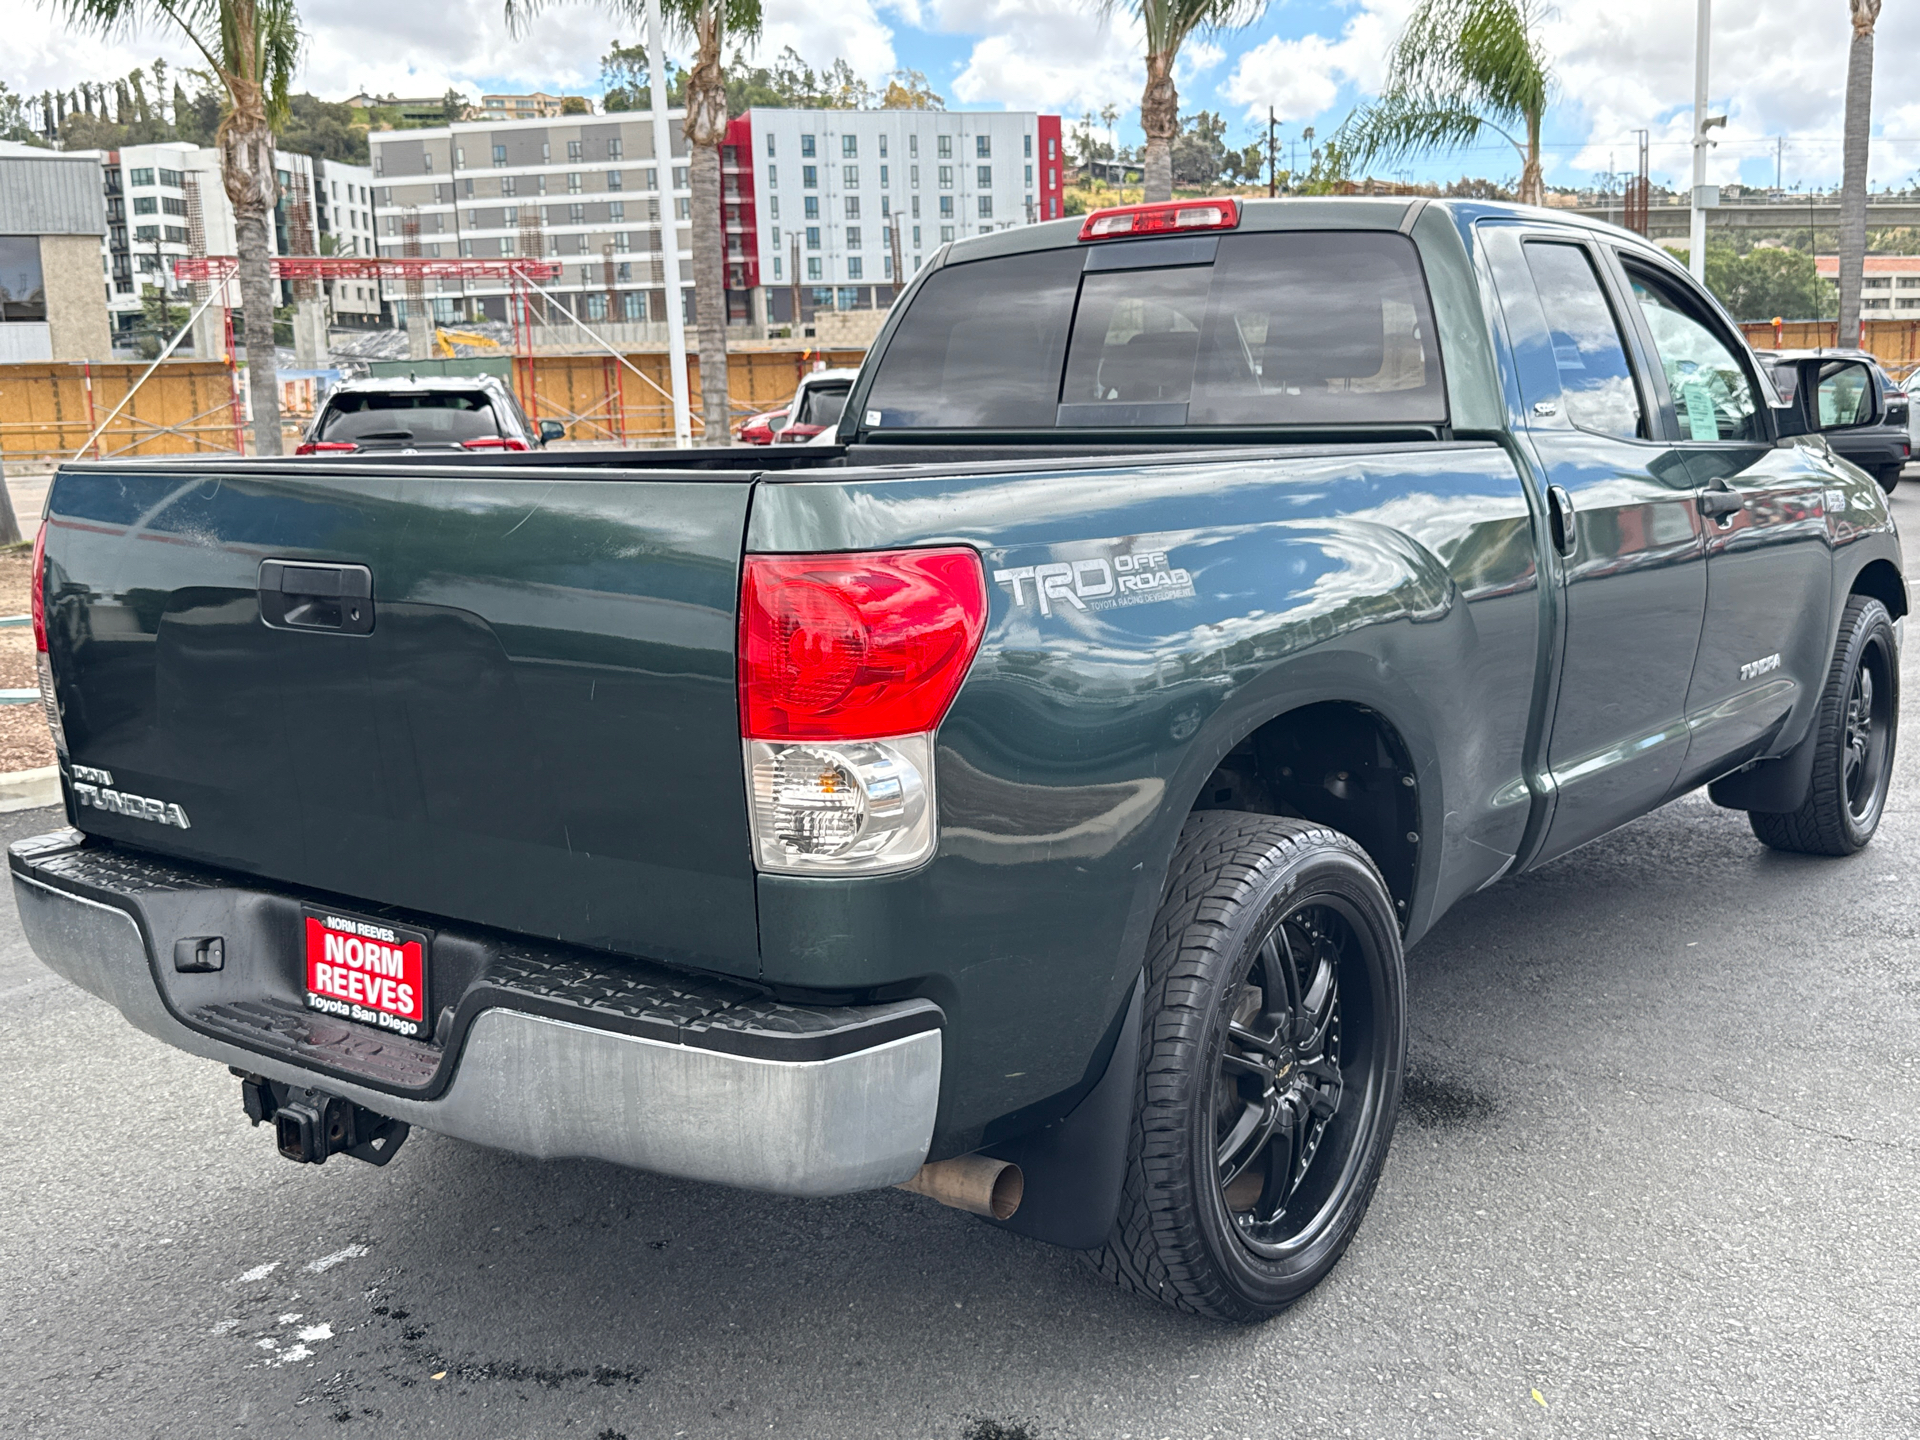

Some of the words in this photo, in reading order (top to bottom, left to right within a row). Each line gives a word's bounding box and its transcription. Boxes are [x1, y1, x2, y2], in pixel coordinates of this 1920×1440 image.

[1114, 551, 1168, 572] OFF
[1117, 568, 1192, 593] ROAD
[993, 557, 1116, 618] TRD
[1090, 599, 1118, 611] TOYOTA
[1118, 595, 1144, 606] RACING
[1144, 588, 1192, 603] DEVELOPMENT
[73, 782, 191, 829] TUNDRA
[327, 915, 356, 934] NORM
[357, 923, 395, 942] REEVES
[324, 933, 404, 979] NORM
[315, 962, 414, 1014] REEVES
[307, 992, 350, 1016] Toyota
[351, 1004, 377, 1023] San
[378, 1011, 418, 1035] Diego
